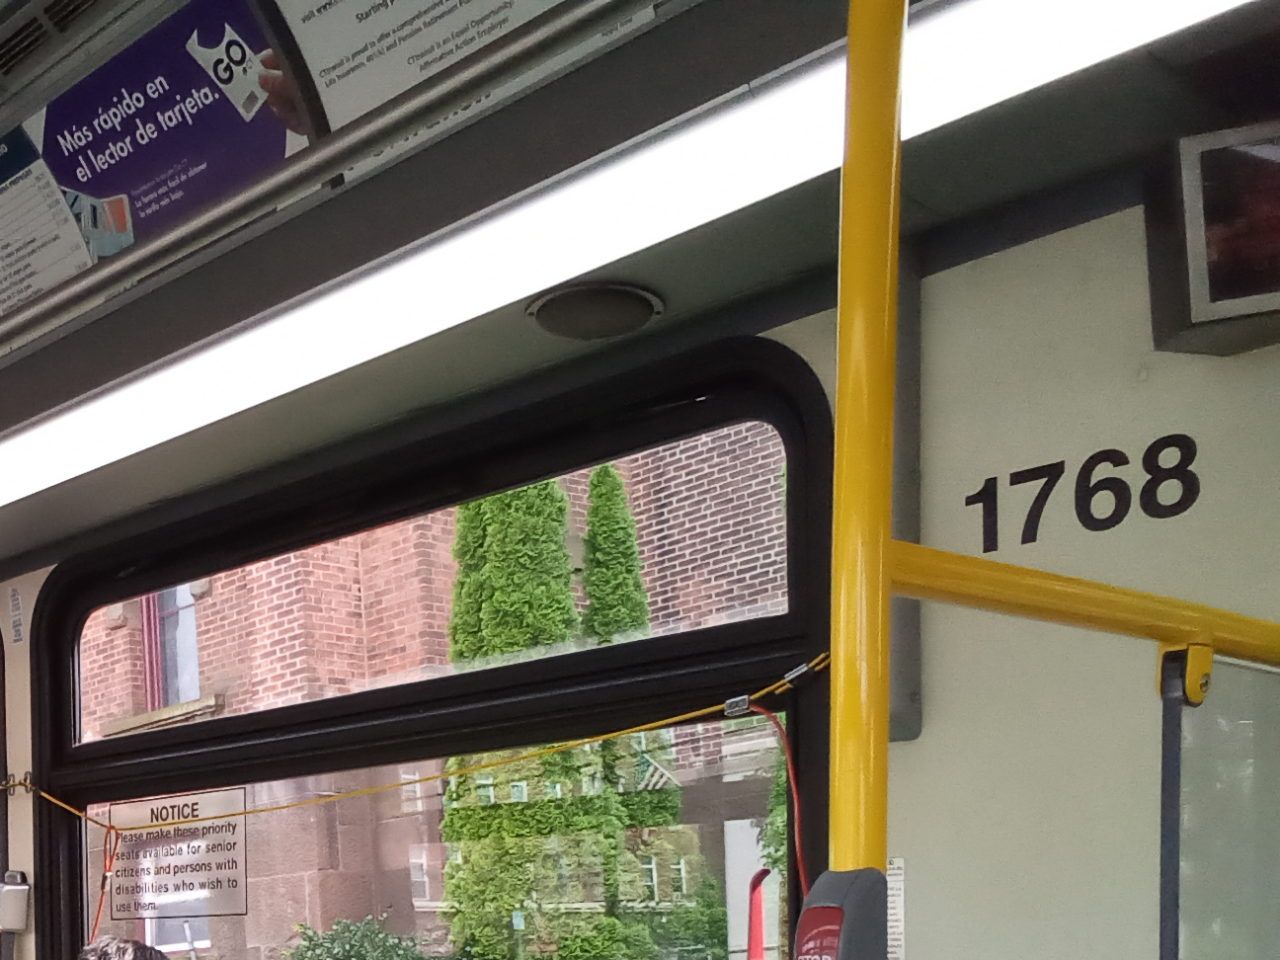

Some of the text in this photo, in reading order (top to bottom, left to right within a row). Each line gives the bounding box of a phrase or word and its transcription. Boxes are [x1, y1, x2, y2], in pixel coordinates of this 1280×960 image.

[355, 0, 390, 23] Starting
[212, 39, 247, 85] GO
[56, 75, 170, 156] Más rápido en
[76, 154, 93, 182] el
[87, 135, 134, 173] lector
[135, 118, 158, 145] de
[156, 86, 220, 132] tarjeta.
[964, 433, 1201, 554] 1768
[149, 801, 200, 823] NOTICE
[145, 828, 171, 841] make
[173, 825, 200, 838] these
[201, 821, 238, 838] priority
[115, 841, 238, 862] seats available for senior
[115, 858, 239, 879] citizens and persons with
[115, 877, 239, 896] disabilities who wish to
[114, 902, 132, 913] use
